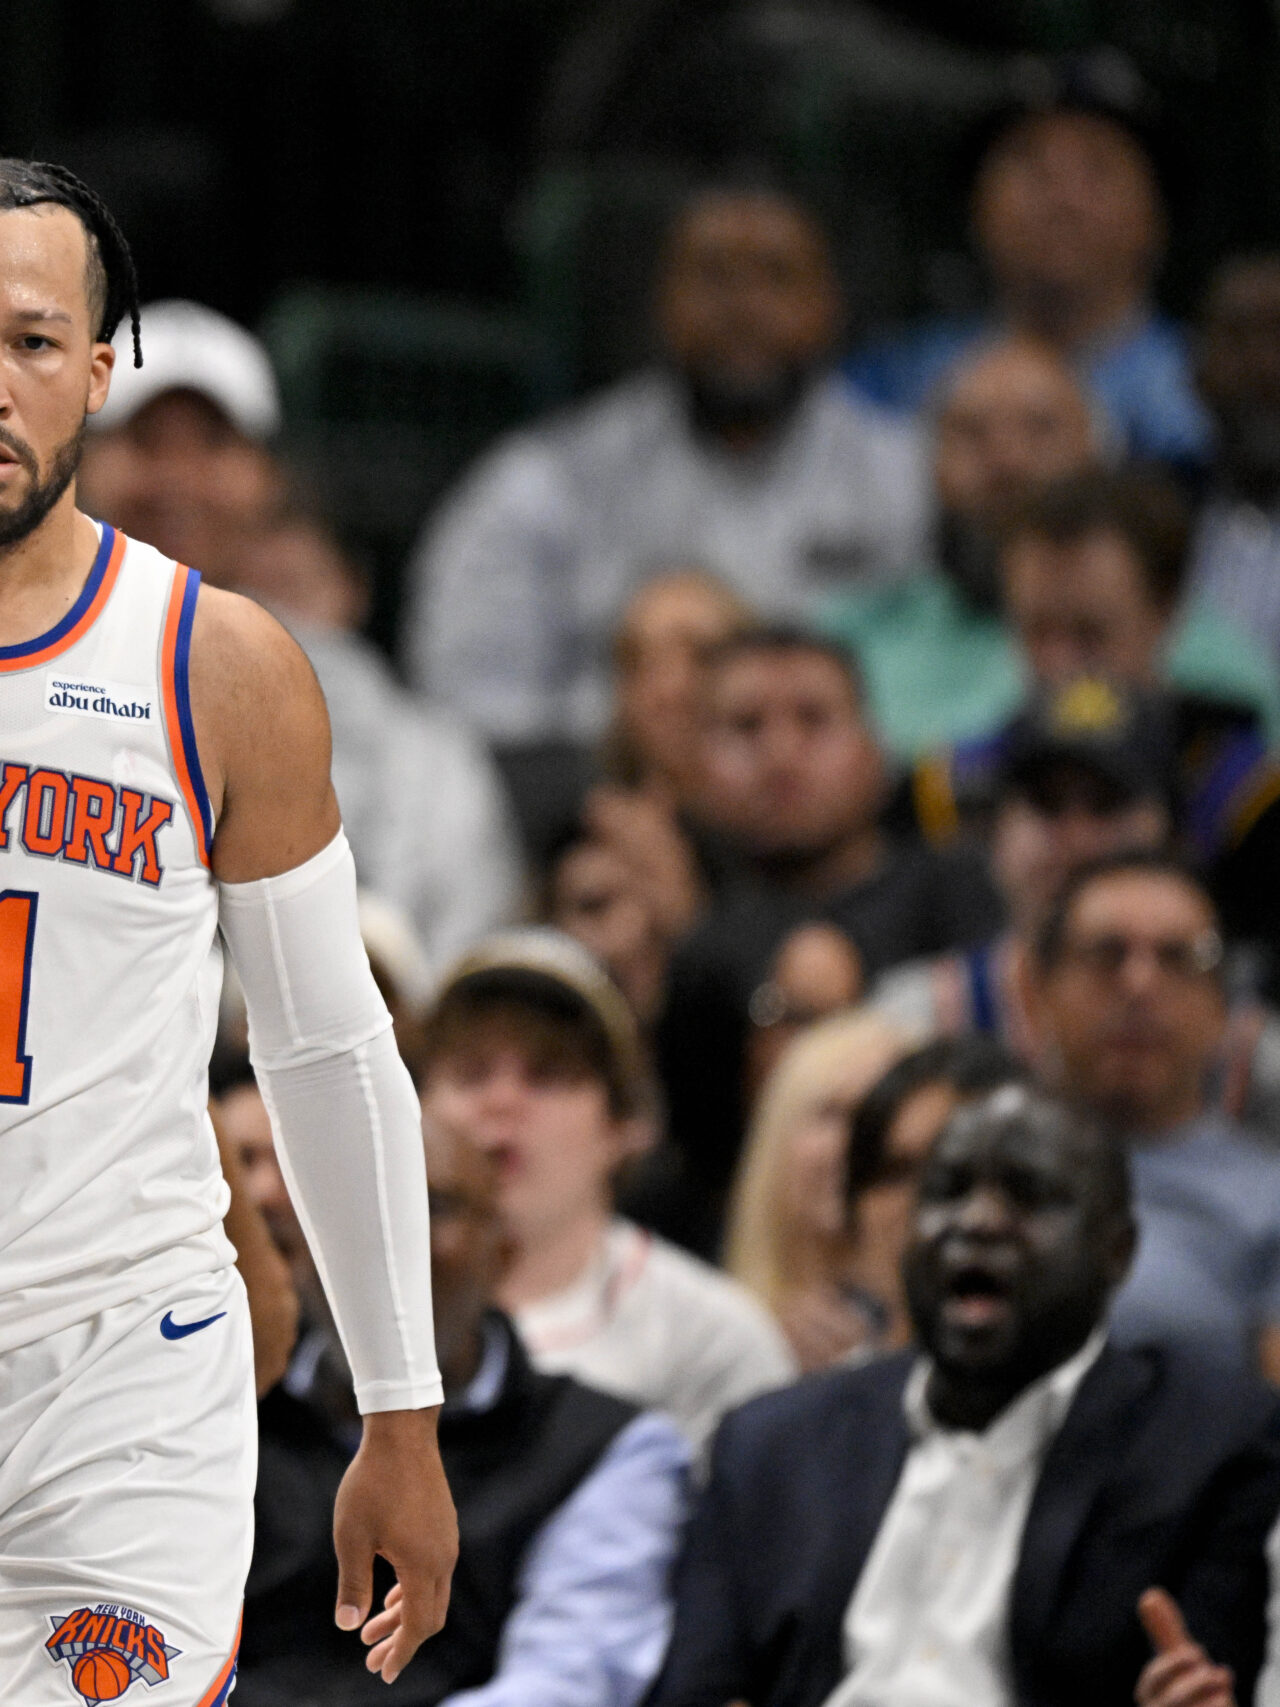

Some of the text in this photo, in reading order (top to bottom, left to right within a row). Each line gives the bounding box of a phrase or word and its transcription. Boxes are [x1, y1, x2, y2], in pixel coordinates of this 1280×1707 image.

[52, 680, 106, 694] experience
[49, 691, 89, 710] abu
[93, 1604, 146, 1626] NEW YORK
[45, 1607, 169, 1681] KNICKS
